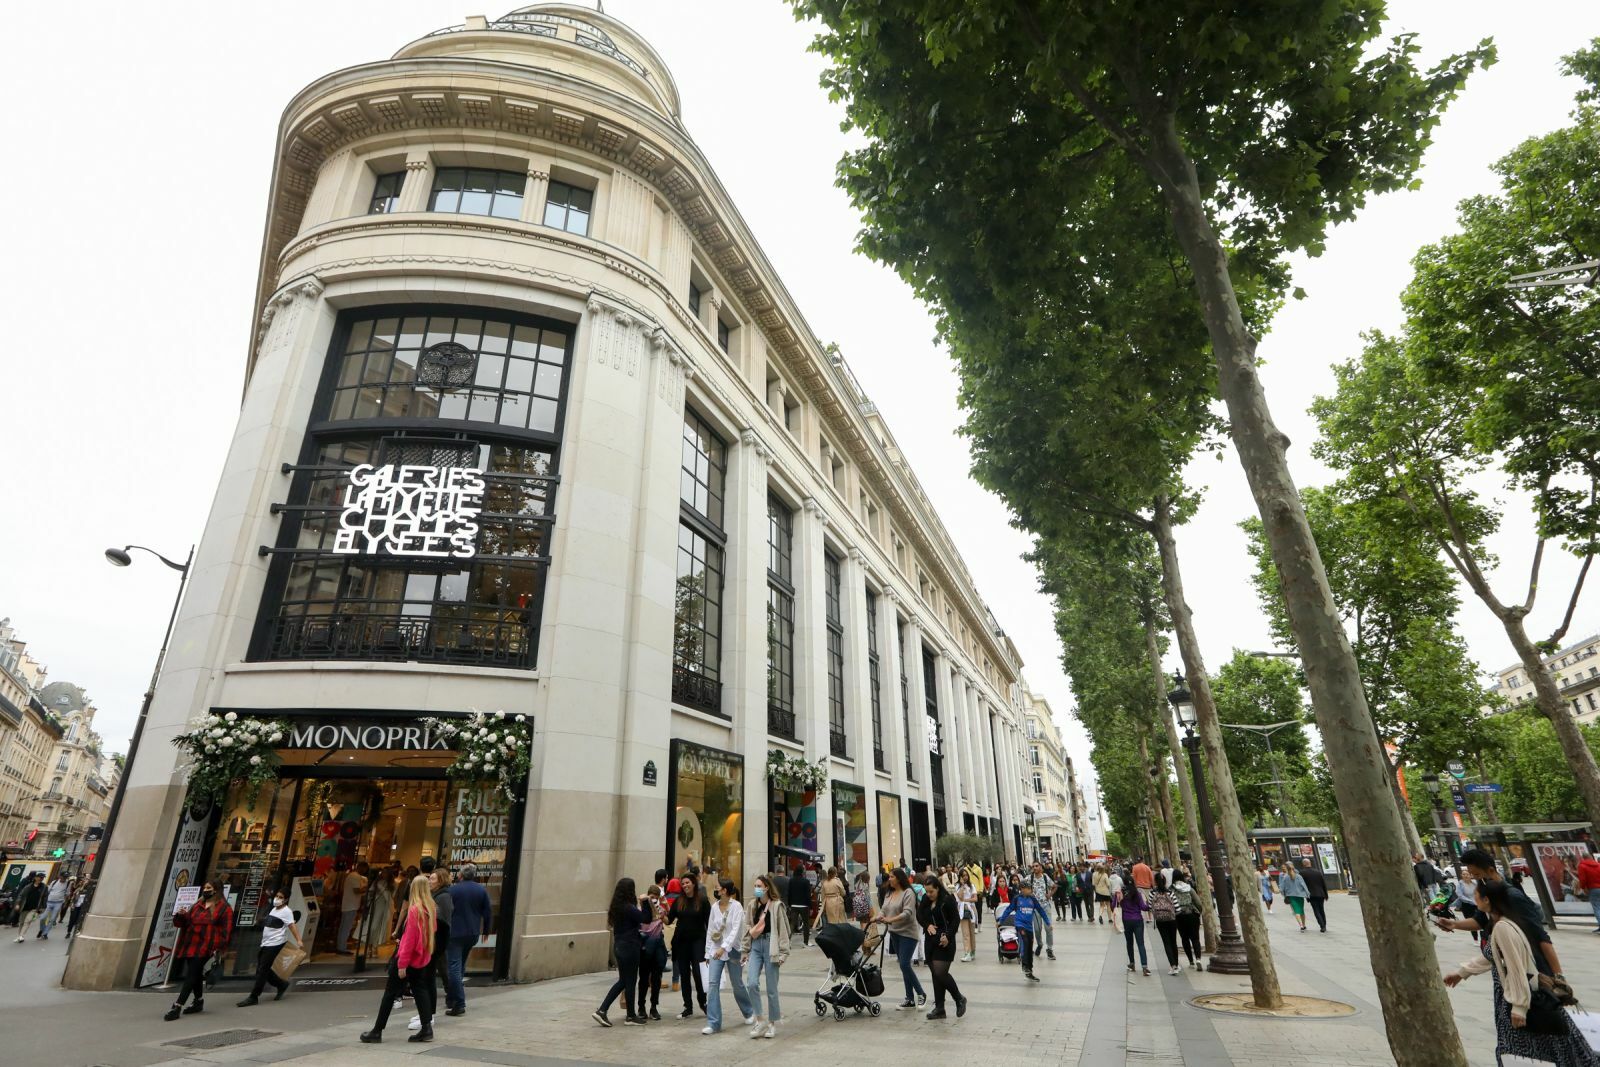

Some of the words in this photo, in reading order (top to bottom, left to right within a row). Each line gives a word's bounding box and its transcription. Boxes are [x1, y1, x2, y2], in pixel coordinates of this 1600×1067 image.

[349, 464, 486, 491] GALERIES
[343, 484, 484, 513] LAFAYETTE
[288, 725, 449, 750] MONOPRIX
[183, 830, 197, 844] BAR
[454, 815, 509, 836] STORE
[176, 845, 200, 863] CRÊPES
